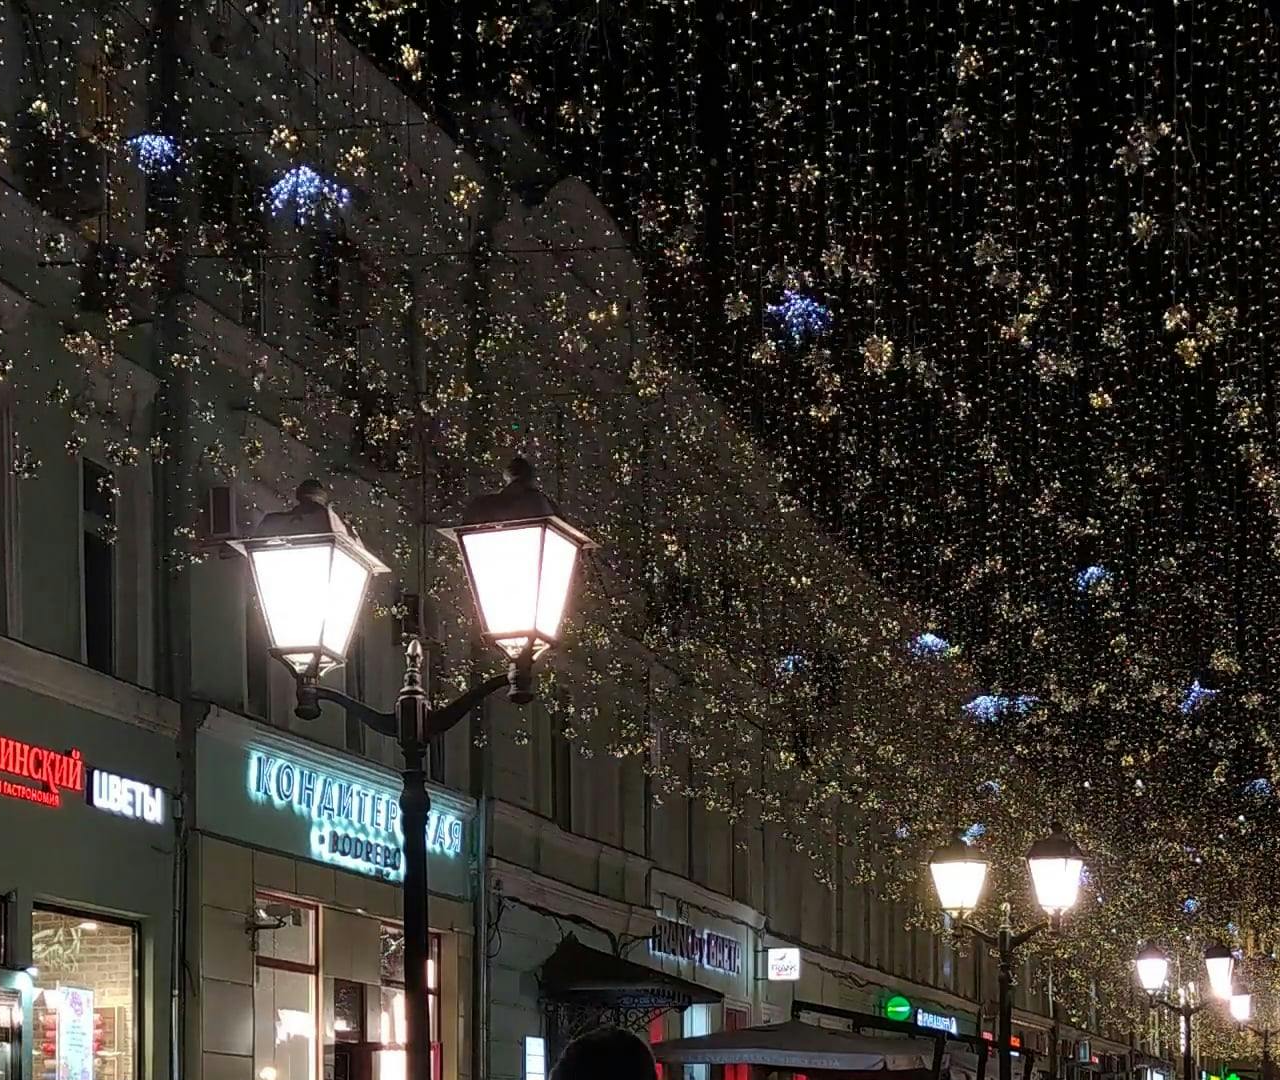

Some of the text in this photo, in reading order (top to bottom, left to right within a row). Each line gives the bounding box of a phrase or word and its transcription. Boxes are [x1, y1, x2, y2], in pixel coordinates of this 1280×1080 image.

[4, 781, 61, 808] ГАСТРОНОМИЯ
[93, 769, 165, 825] ЦВЕТЫ
[257, 755, 463, 852] КОНДИТЕРАЯ
